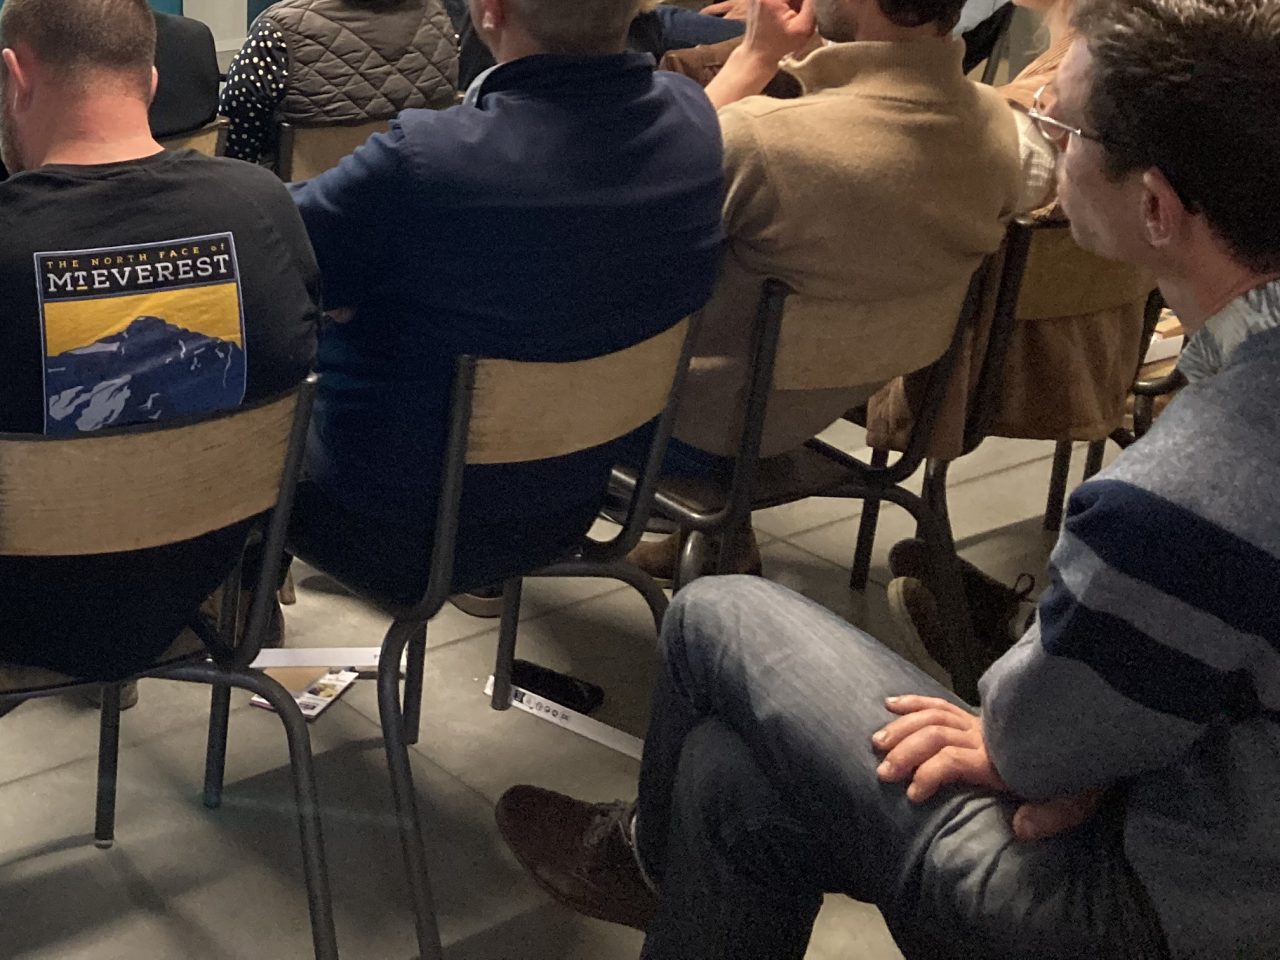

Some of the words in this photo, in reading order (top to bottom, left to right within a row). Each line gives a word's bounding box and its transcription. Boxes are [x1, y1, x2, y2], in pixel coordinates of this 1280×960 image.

[46, 259, 79, 269] THE
[91, 253, 148, 267] NORTH
[159, 246, 200, 259] FACE
[211, 243, 225, 252] of
